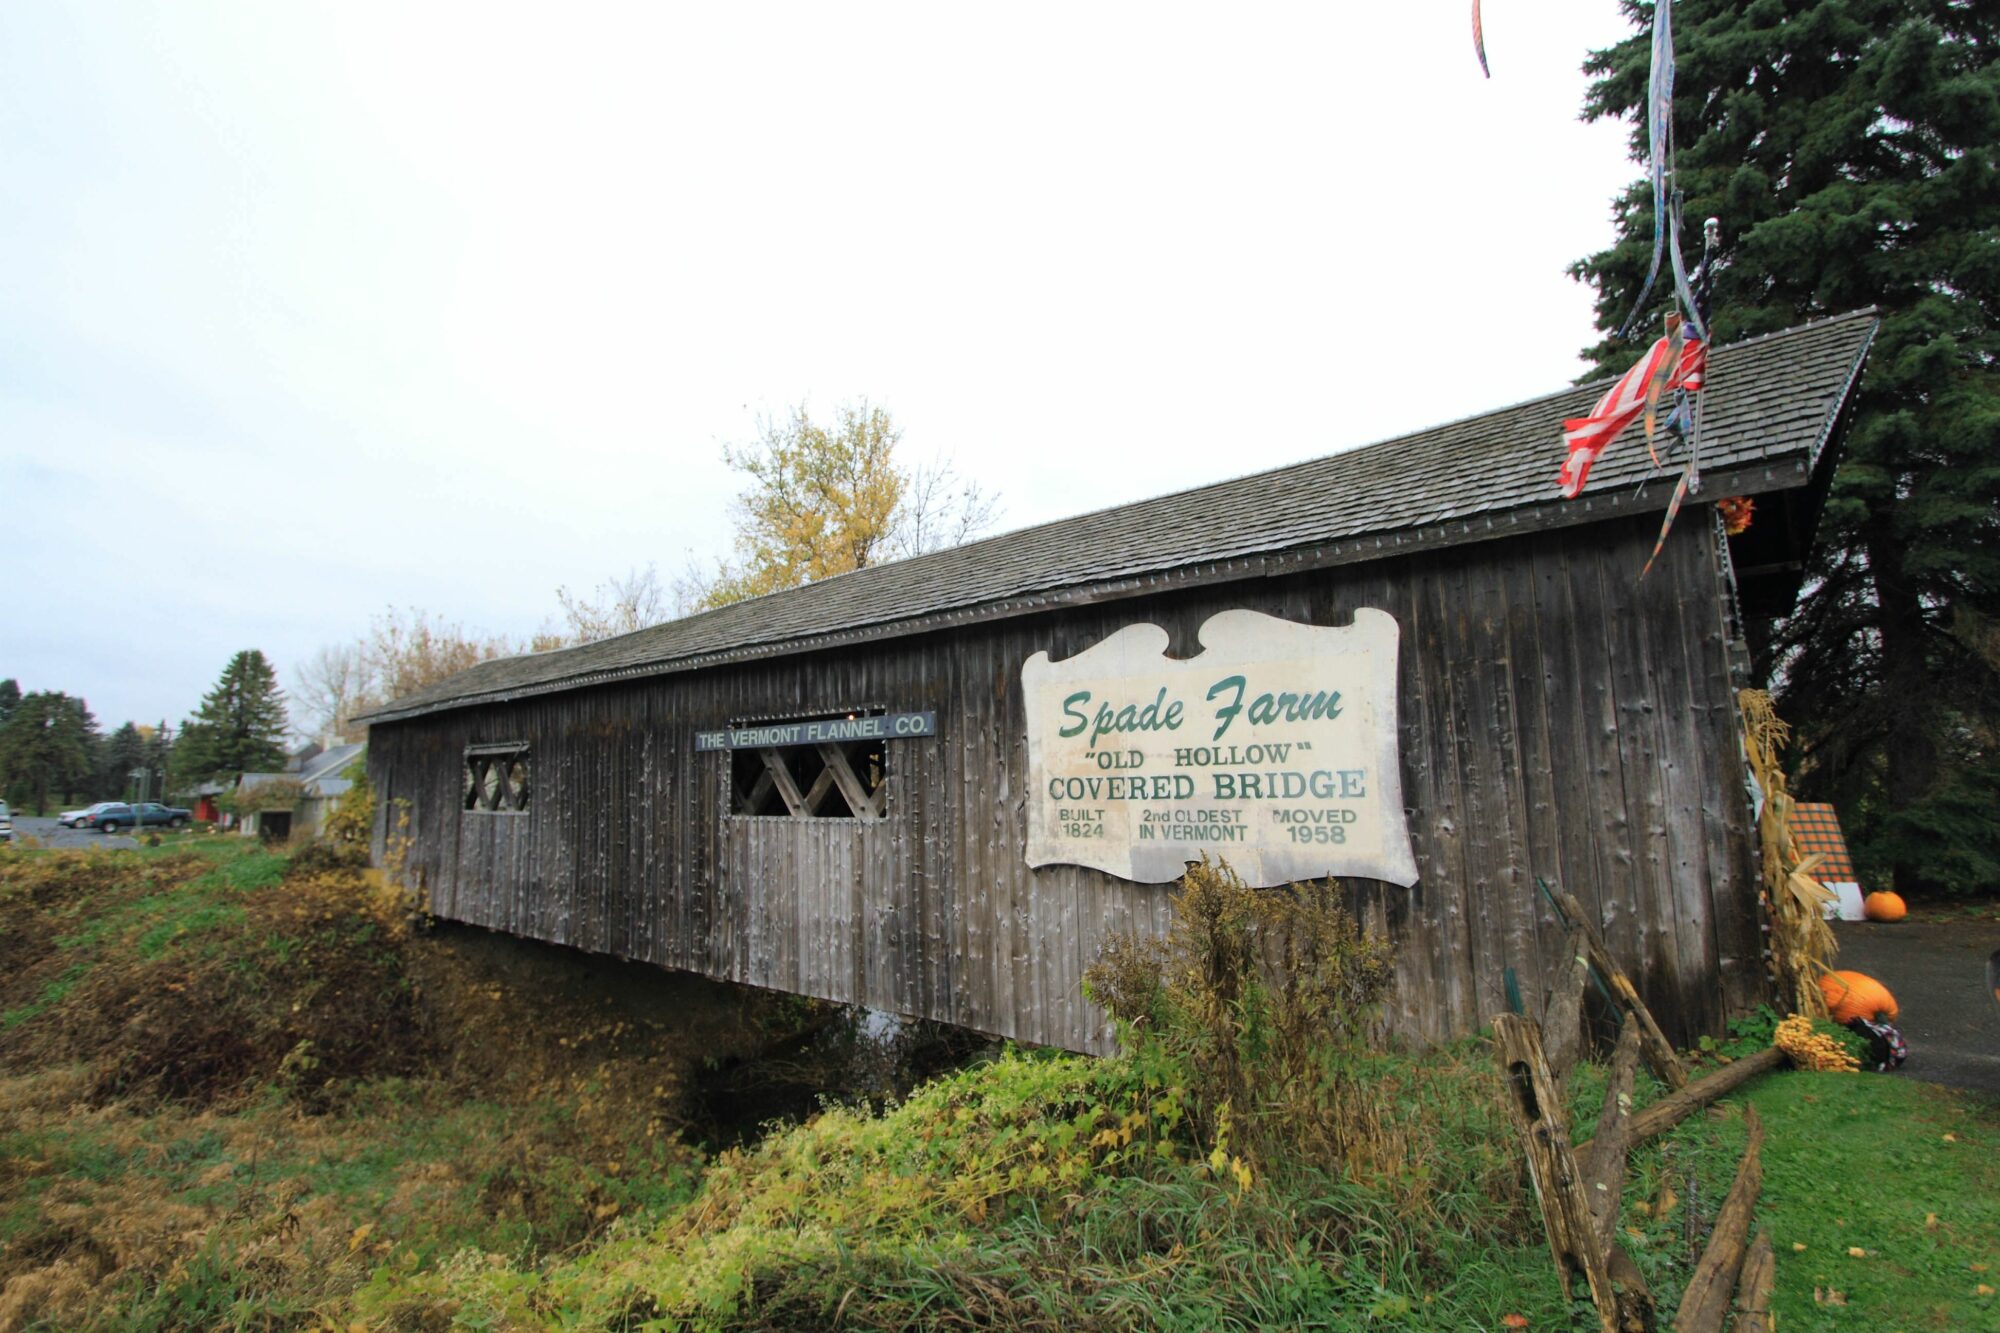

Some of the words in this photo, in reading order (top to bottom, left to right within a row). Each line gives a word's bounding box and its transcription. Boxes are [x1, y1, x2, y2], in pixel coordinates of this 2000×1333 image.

[1059, 686, 1184, 747] Spade
[1206, 675, 1344, 742] Farm
[699, 733, 725, 748] THE
[730, 726, 801, 746] VERMONT
[807, 719, 884, 740] FLANNEL
[895, 715, 928, 735] CO.
[1049, 775, 1195, 801] COVERED
[1212, 769, 1366, 800] BRIDGE
[1060, 809, 1105, 822] BUILT
[1143, 809, 1171, 823] 2nd
[1175, 809, 1243, 824] OLDEST
[1272, 809, 1357, 825] MOVED
[1062, 823, 1104, 839] 1824
[1139, 824, 1157, 840] IN
[1161, 824, 1248, 842] VERMONT
[1286, 826, 1347, 844] 1958
